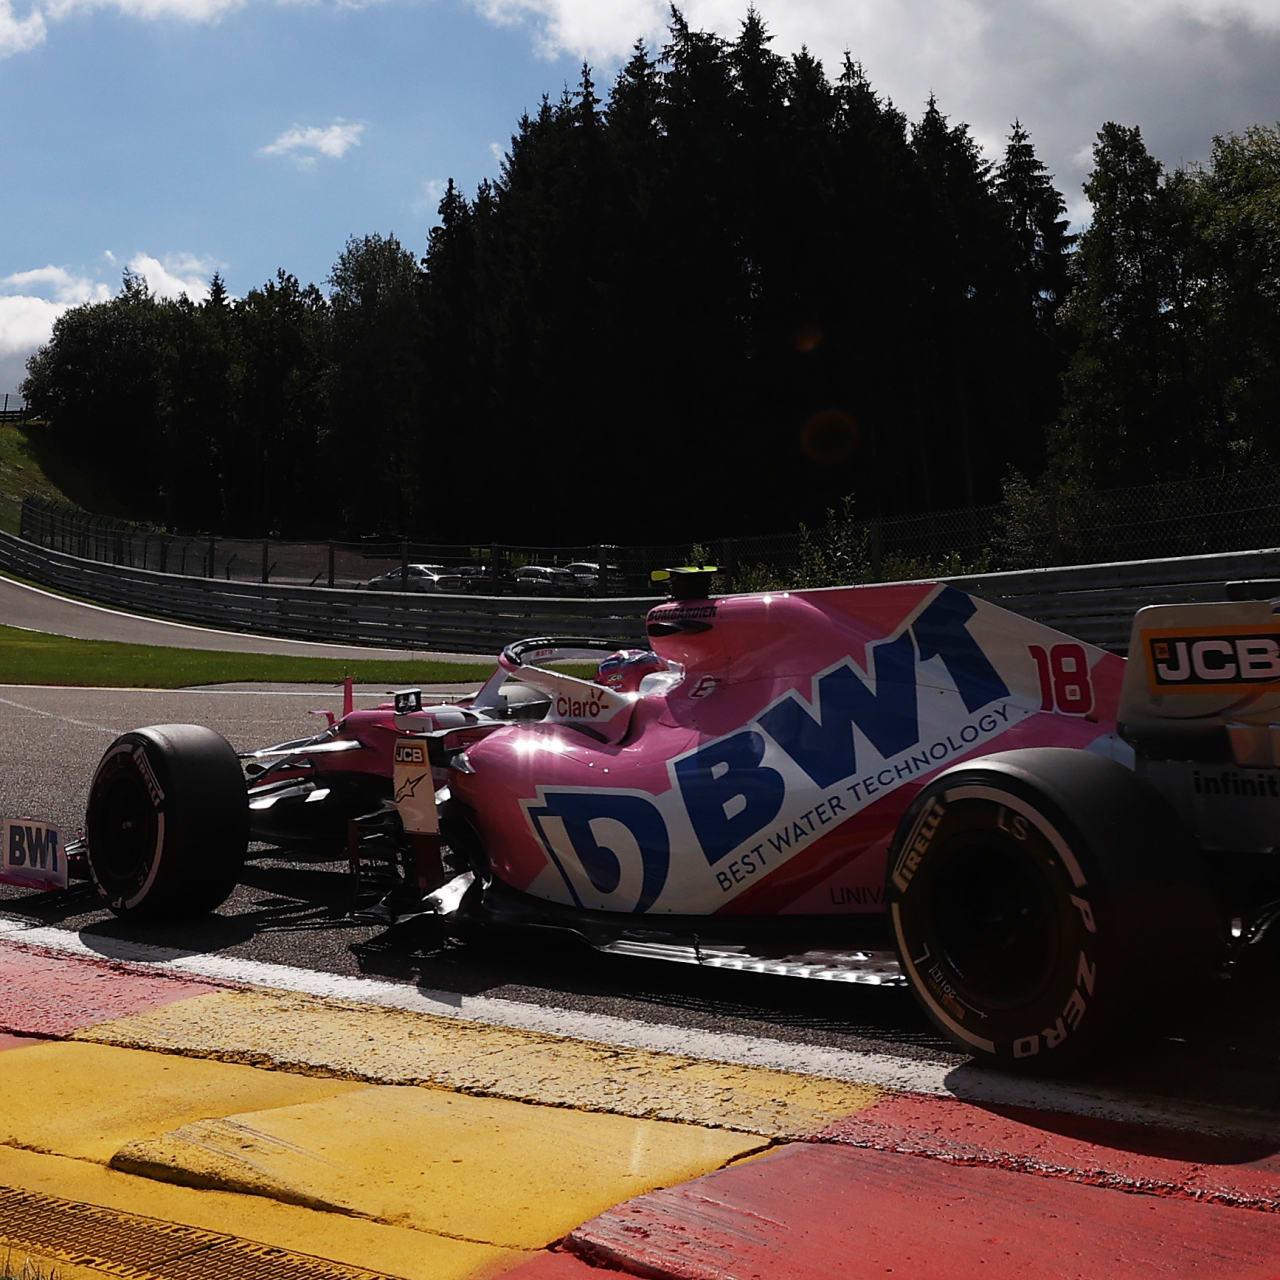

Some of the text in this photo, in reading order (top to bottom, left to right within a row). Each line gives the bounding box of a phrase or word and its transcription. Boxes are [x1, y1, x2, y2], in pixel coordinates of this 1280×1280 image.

[1028, 643, 1092, 713] 18
[395, 749, 424, 763] JCB
[674, 586, 1011, 867] BWT
[716, 704, 1010, 893] BEST WATER TECHNOLOGY
[8, 824, 58, 872] BWT
[829, 886, 885, 905] UNIV
[1012, 950, 1097, 1059] ZERO
